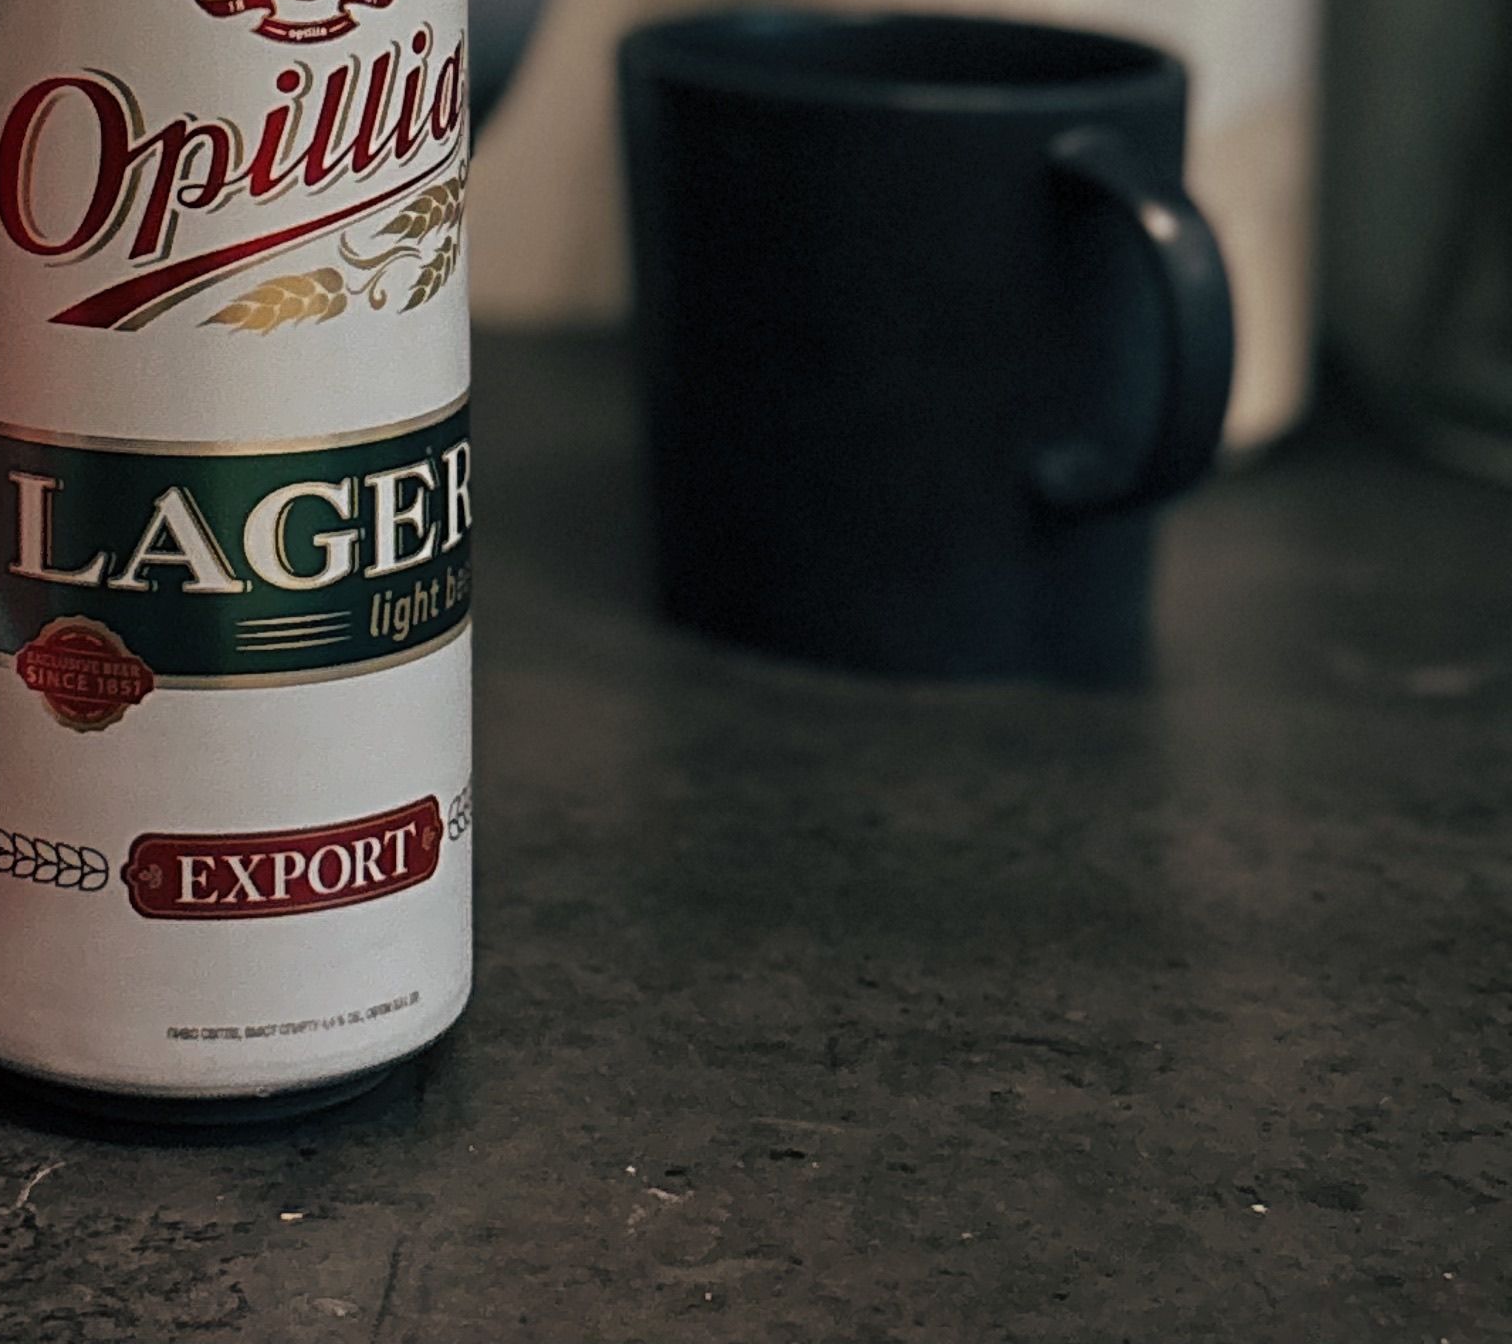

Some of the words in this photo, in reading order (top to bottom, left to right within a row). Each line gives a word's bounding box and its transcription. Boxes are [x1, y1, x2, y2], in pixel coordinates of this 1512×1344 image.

[7, 438, 472, 594] LAGER
[370, 577, 439, 641] light
[26, 665, 89, 691] SINCE
[96, 676, 142, 696] 1851
[175, 821, 417, 903] EXPORT
